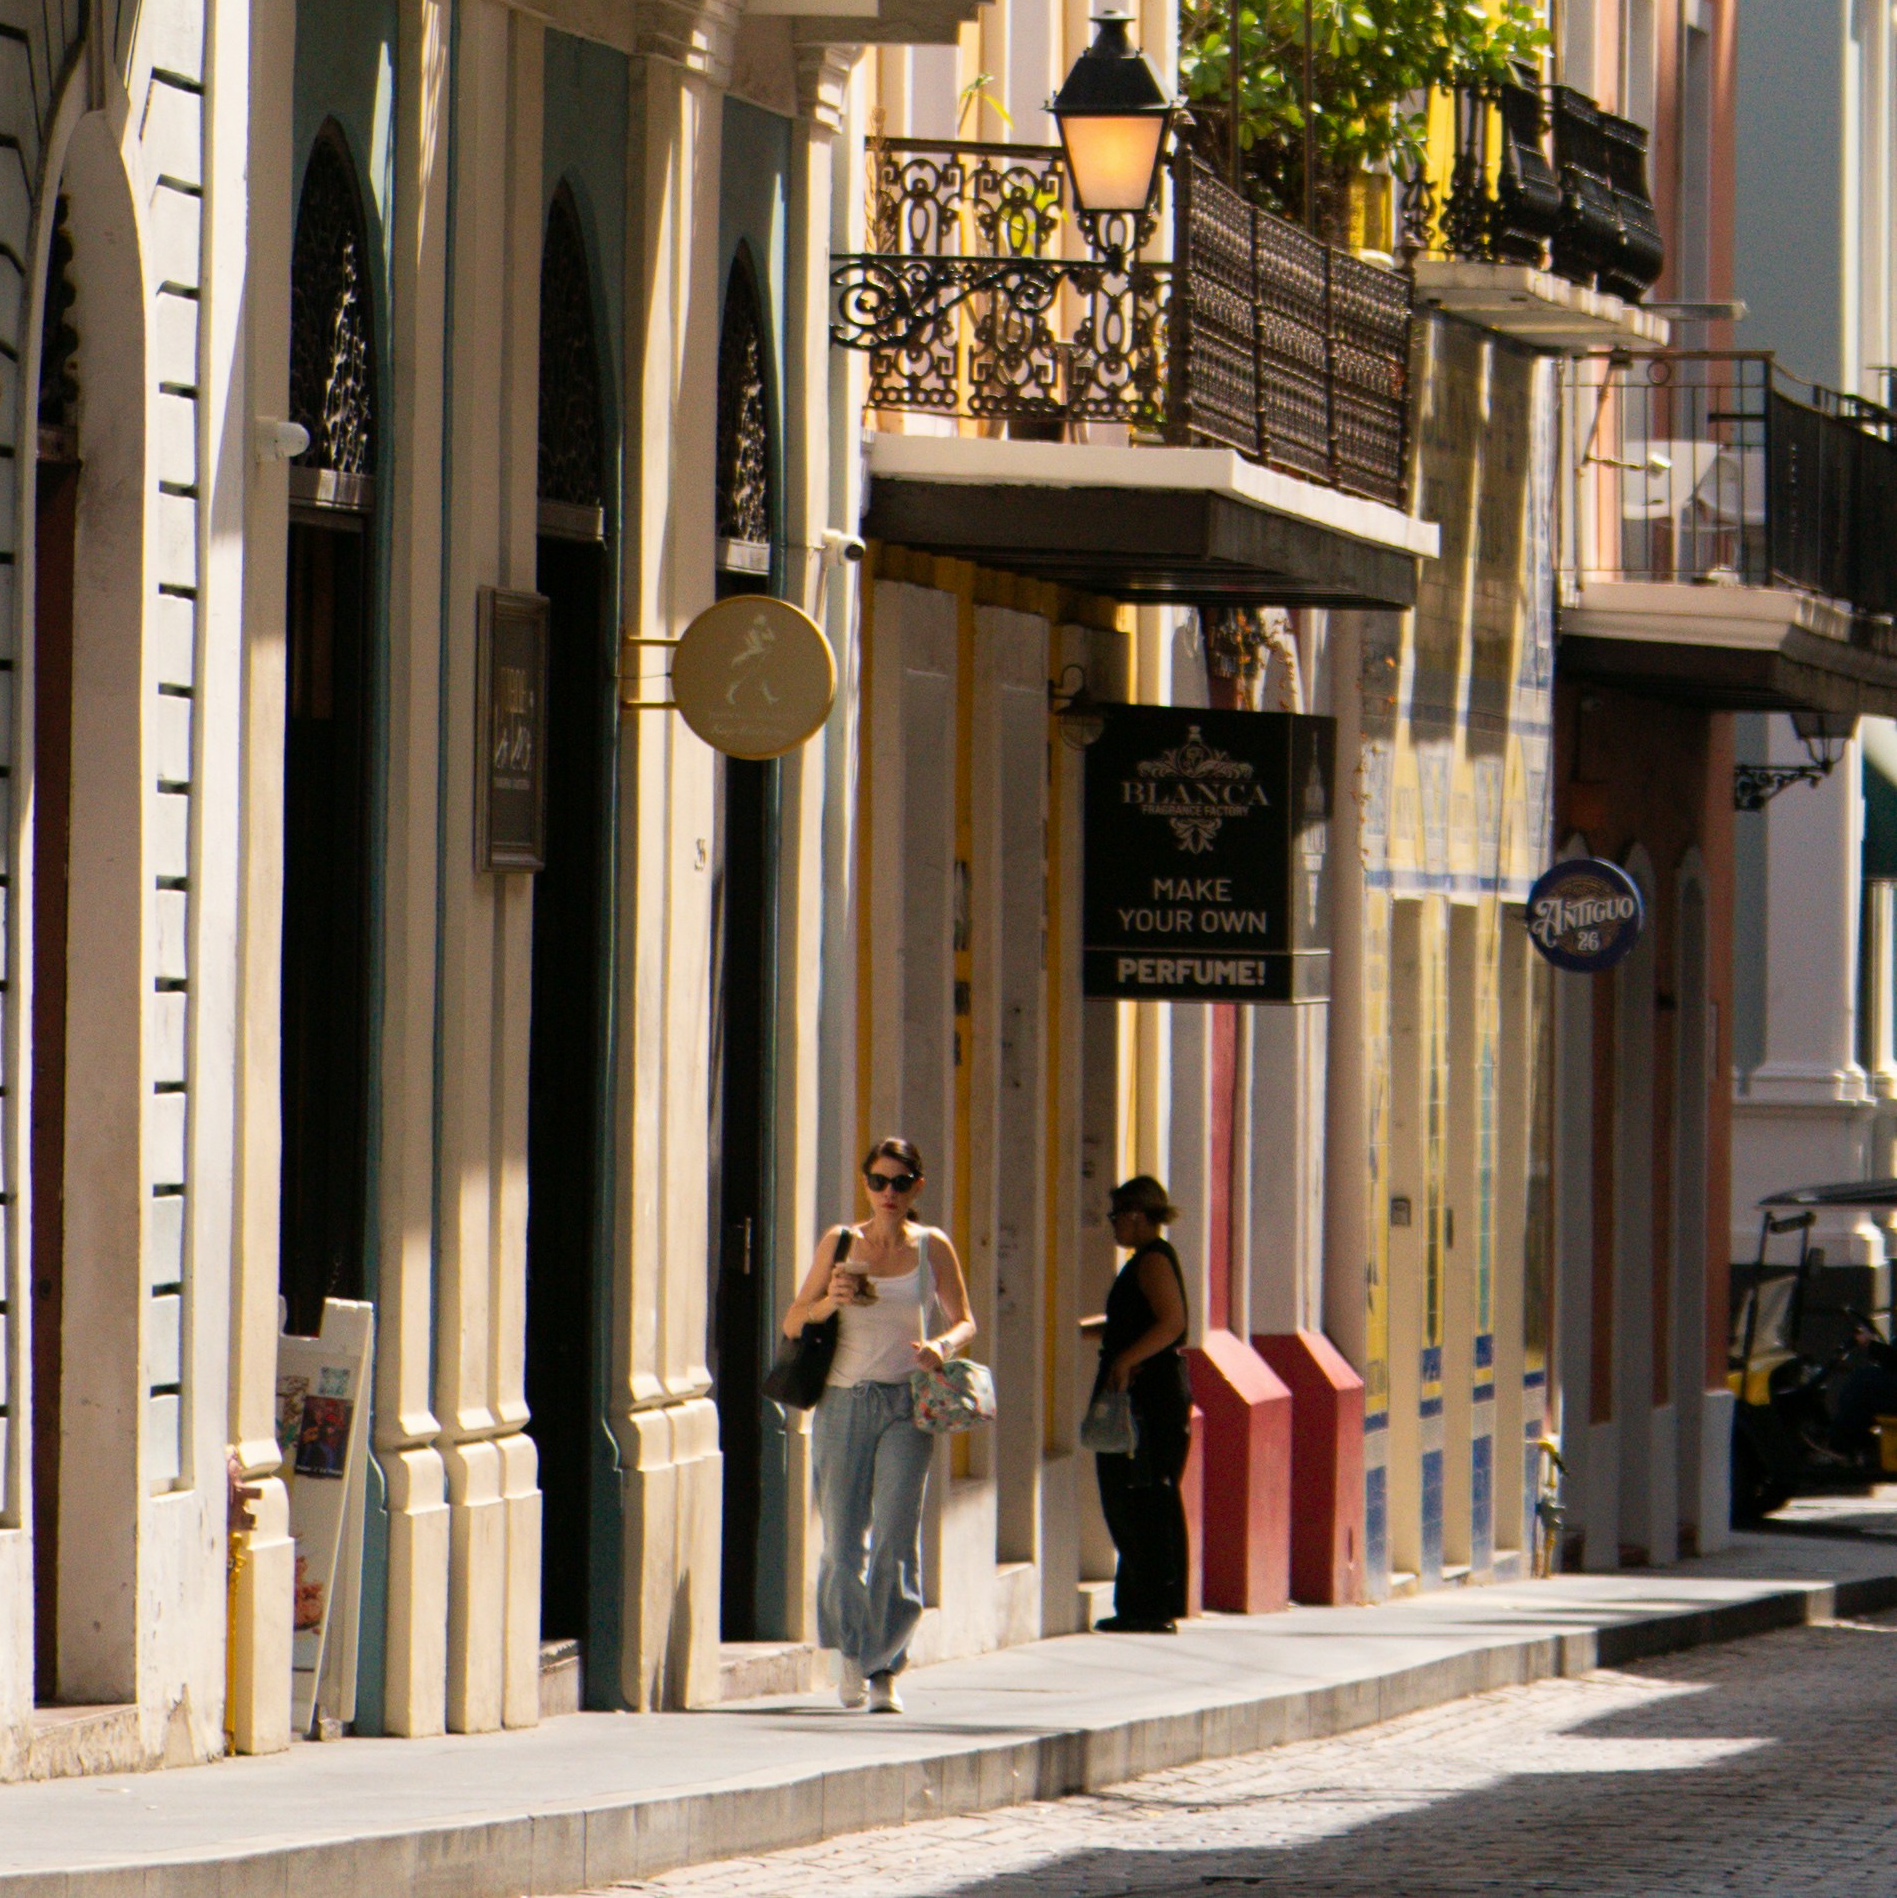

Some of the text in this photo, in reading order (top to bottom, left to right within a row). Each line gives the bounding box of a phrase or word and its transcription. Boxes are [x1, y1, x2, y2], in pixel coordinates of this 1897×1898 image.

[1121, 781, 1271, 806] BLANCA
[1141, 804, 1250, 817] FRAGRANCE FACTORY
[1153, 878, 1233, 902] MAKE
[1118, 909, 1267, 934] YOUR OWN
[1577, 931, 1600, 952] 26
[1117, 957, 1266, 986] PERFUME!
